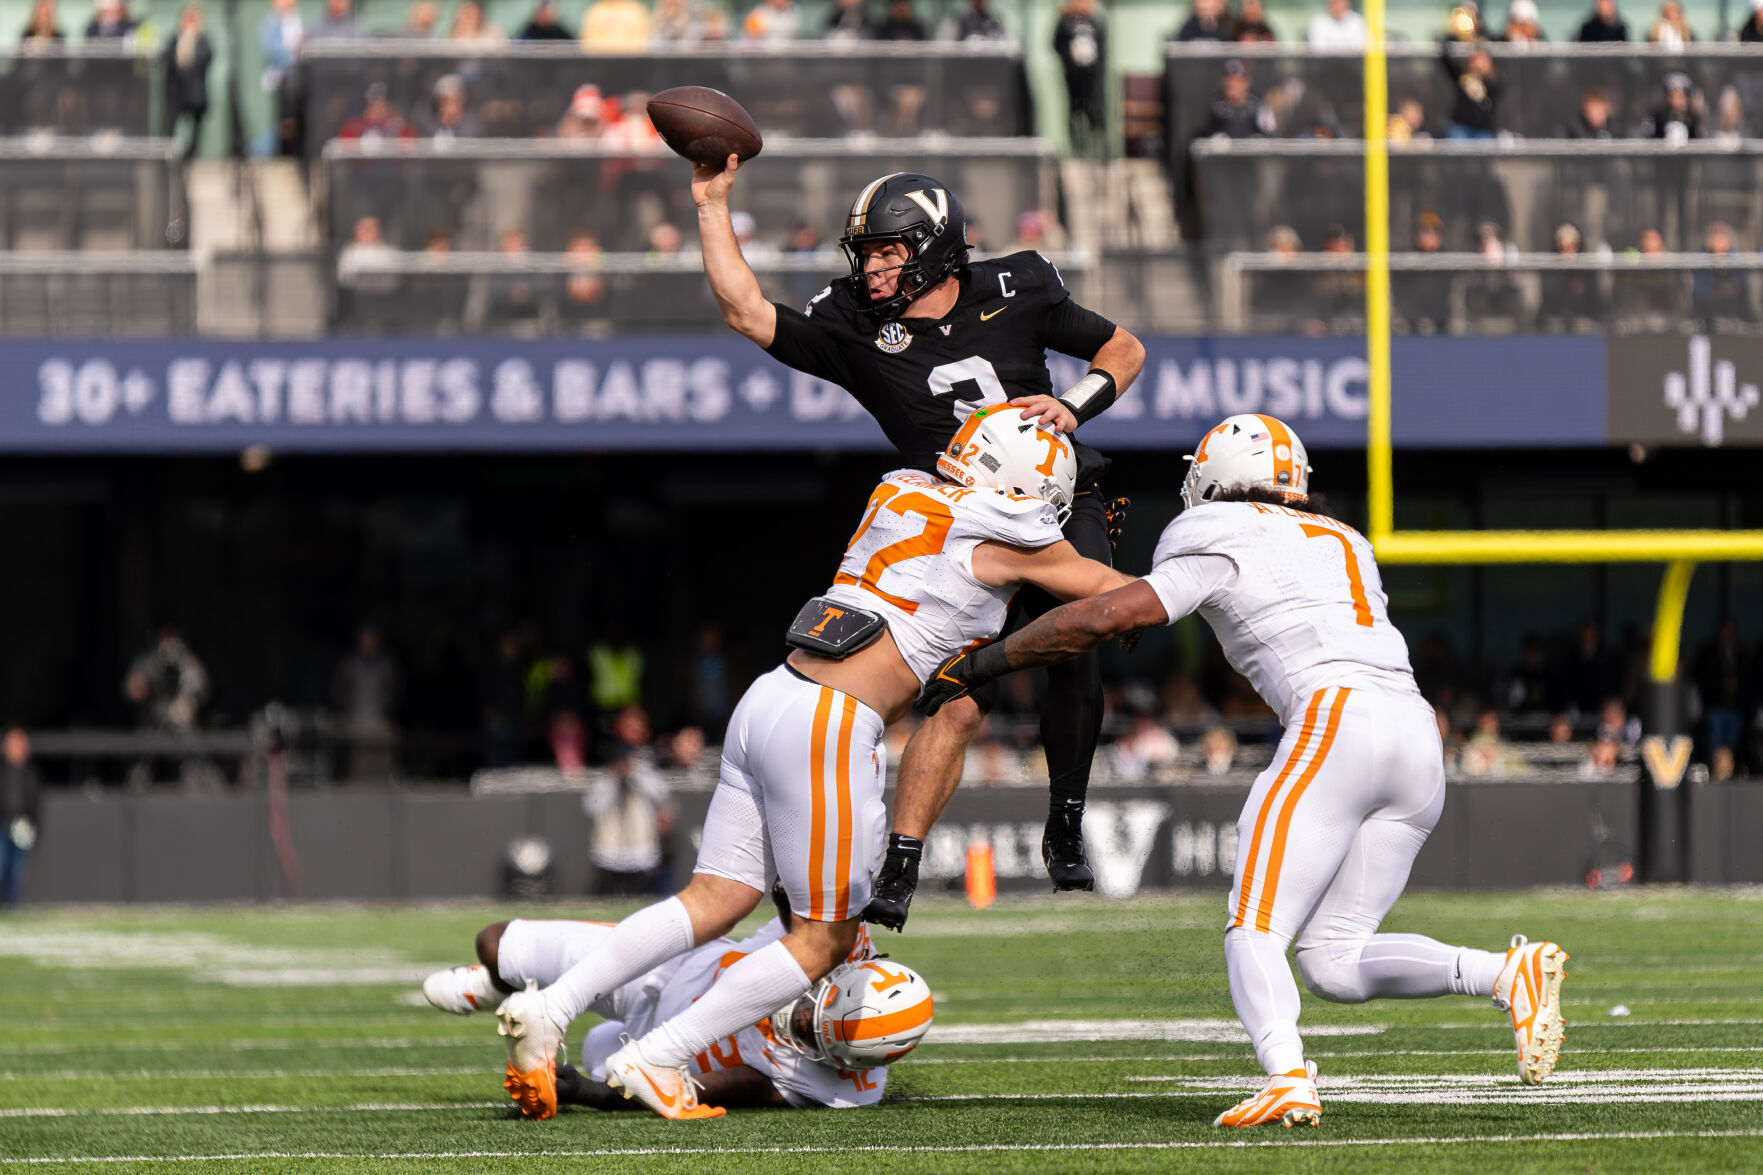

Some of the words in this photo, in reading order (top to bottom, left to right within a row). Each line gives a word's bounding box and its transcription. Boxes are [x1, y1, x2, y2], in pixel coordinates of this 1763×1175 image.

[904, 187, 949, 225] V
[997, 271, 1016, 298] C
[880, 340, 910, 353] GRADUATE
[881, 322, 905, 345] SEC
[938, 324, 952, 336] V
[37, 357, 158, 425] 30+
[166, 357, 480, 425] EATERIES
[489, 356, 544, 424] &
[552, 357, 732, 424] BARS
[927, 355, 1009, 423] 2
[1154, 357, 1369, 420] MUSIC
[960, 443, 980, 467] 2
[1034, 427, 1069, 478] T
[1294, 463, 1301, 488] 7
[833, 483, 955, 617] 22
[1298, 523, 1375, 628] 7
[811, 606, 845, 634] T
[1641, 735, 1693, 790] V
[1083, 800, 1173, 898] V
[858, 961, 909, 993] T
